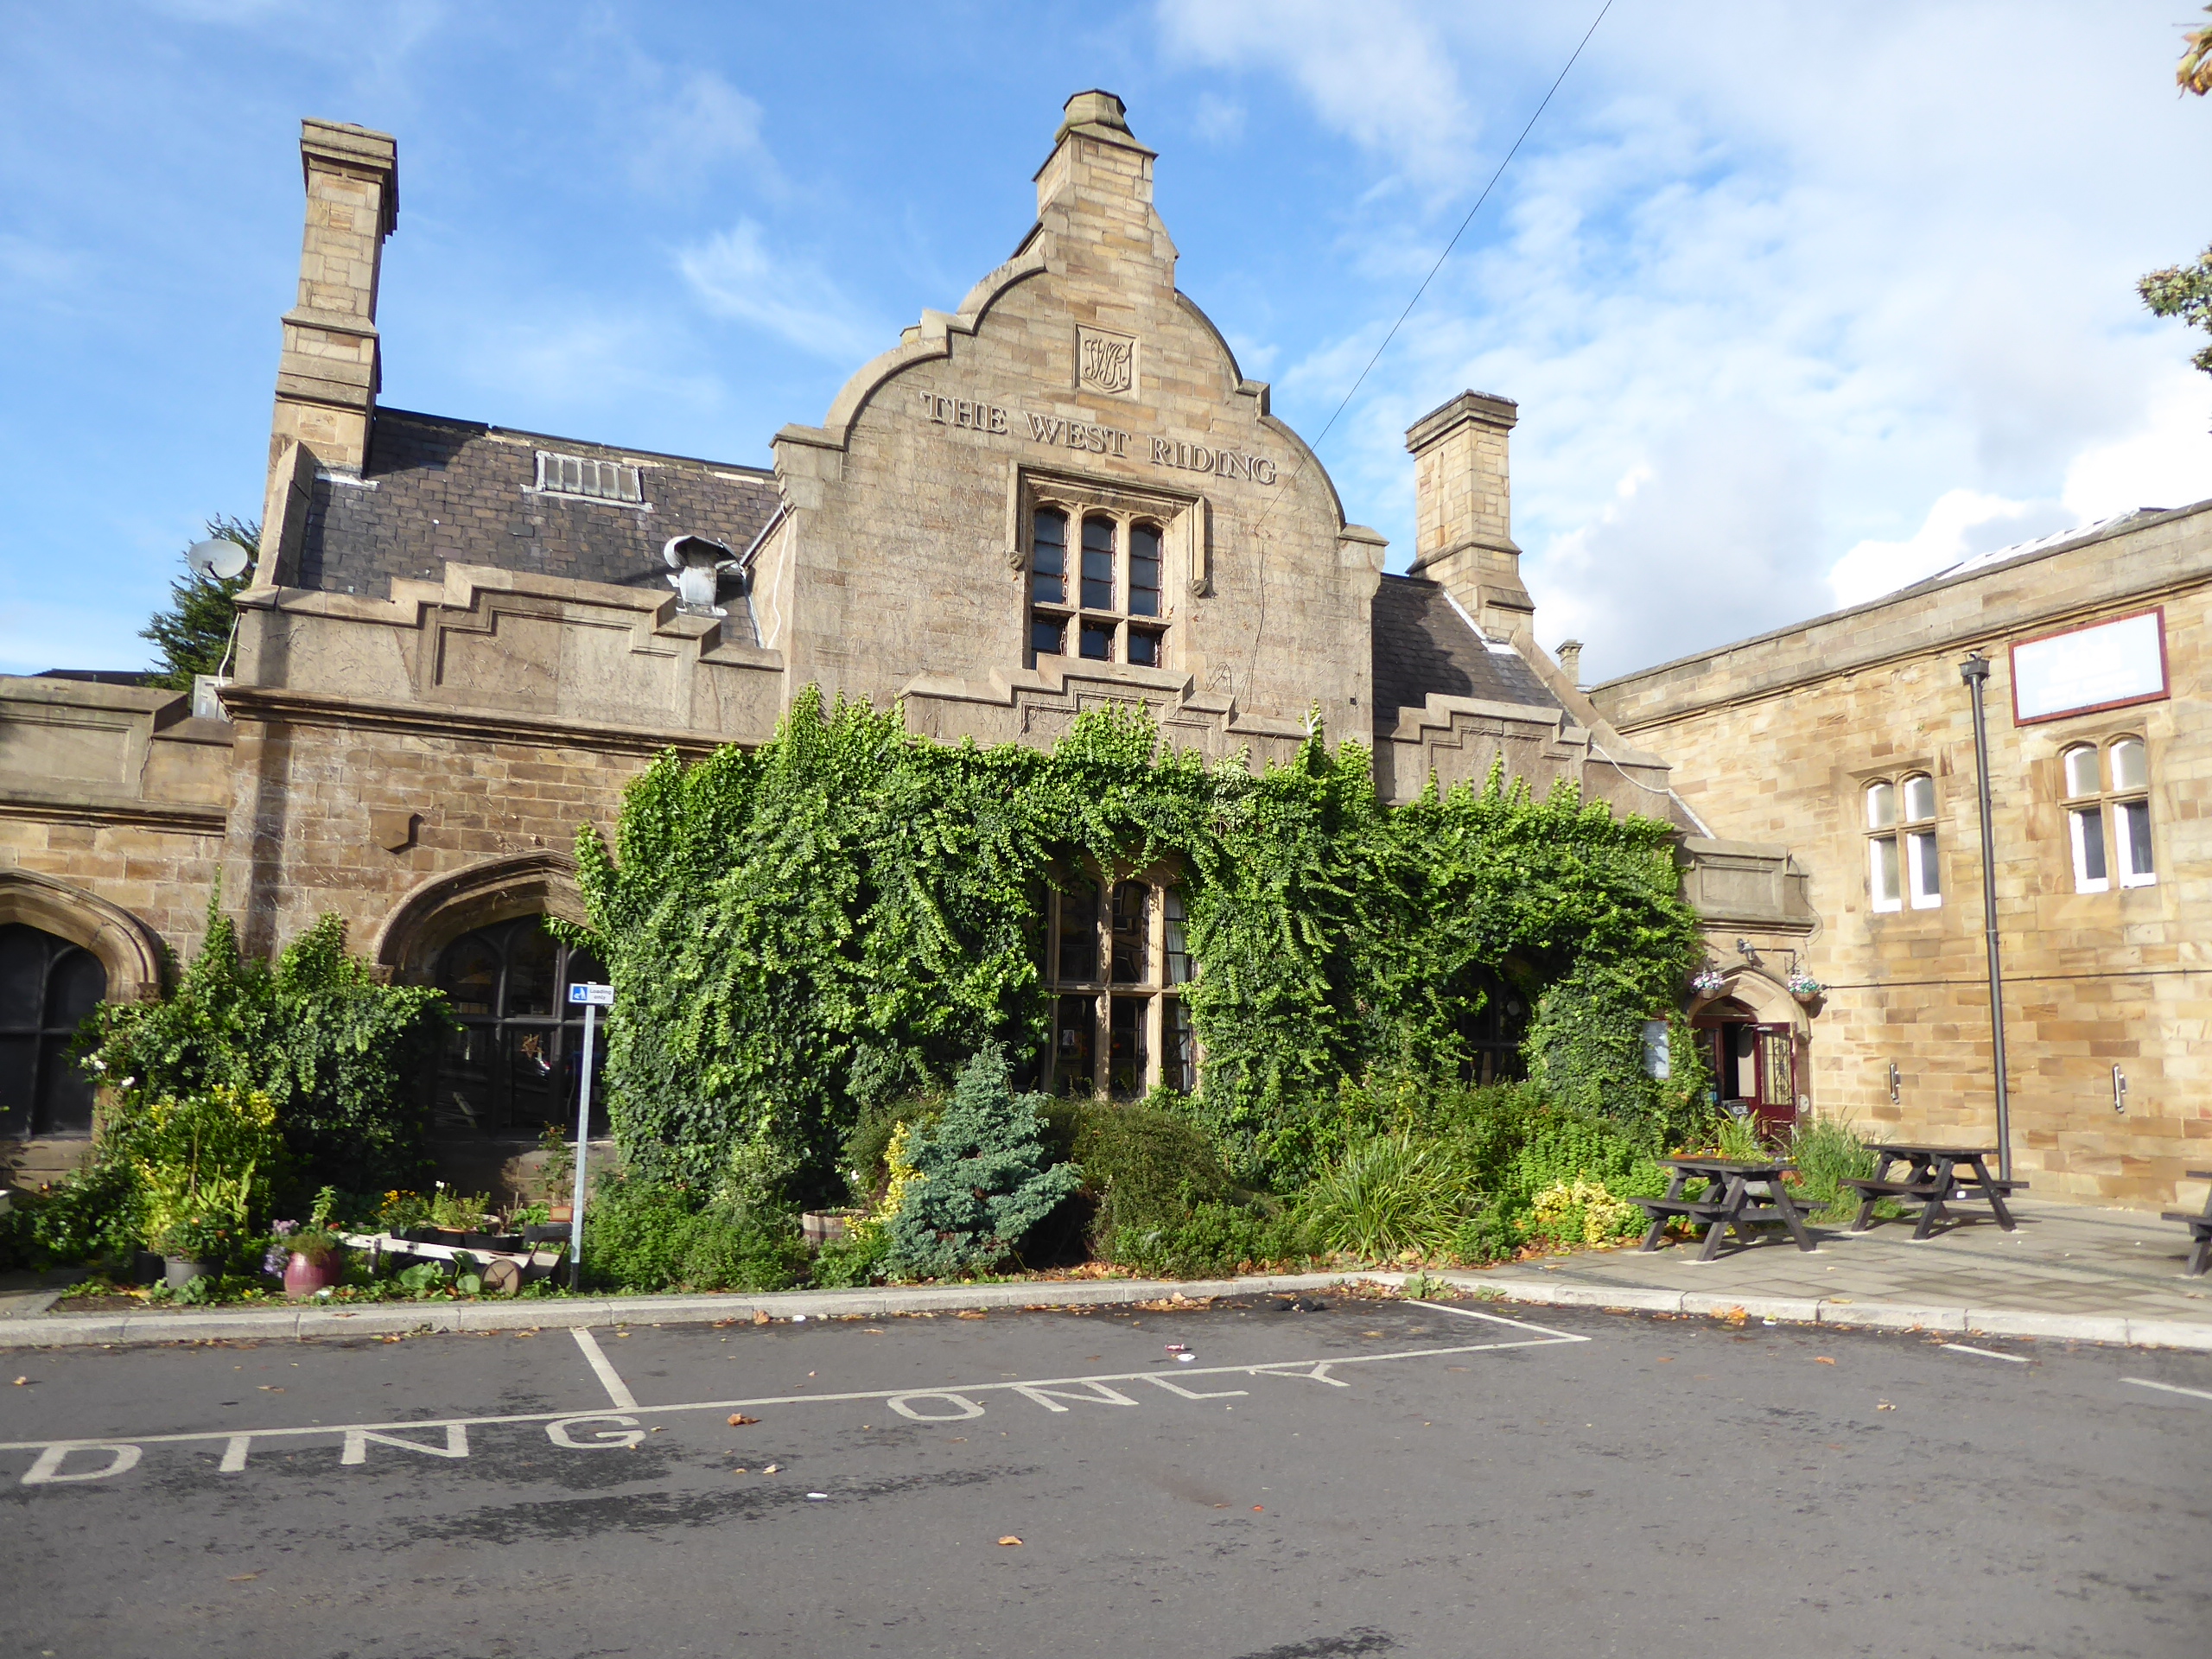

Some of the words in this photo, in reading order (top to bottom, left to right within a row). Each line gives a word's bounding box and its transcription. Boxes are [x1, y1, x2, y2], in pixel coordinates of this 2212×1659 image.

[920, 391, 1007, 434] THE
[1024, 410, 1130, 456] WEST
[1147, 435, 1275, 484] RIDING
[887, 1362, 1351, 1421] ONLY
